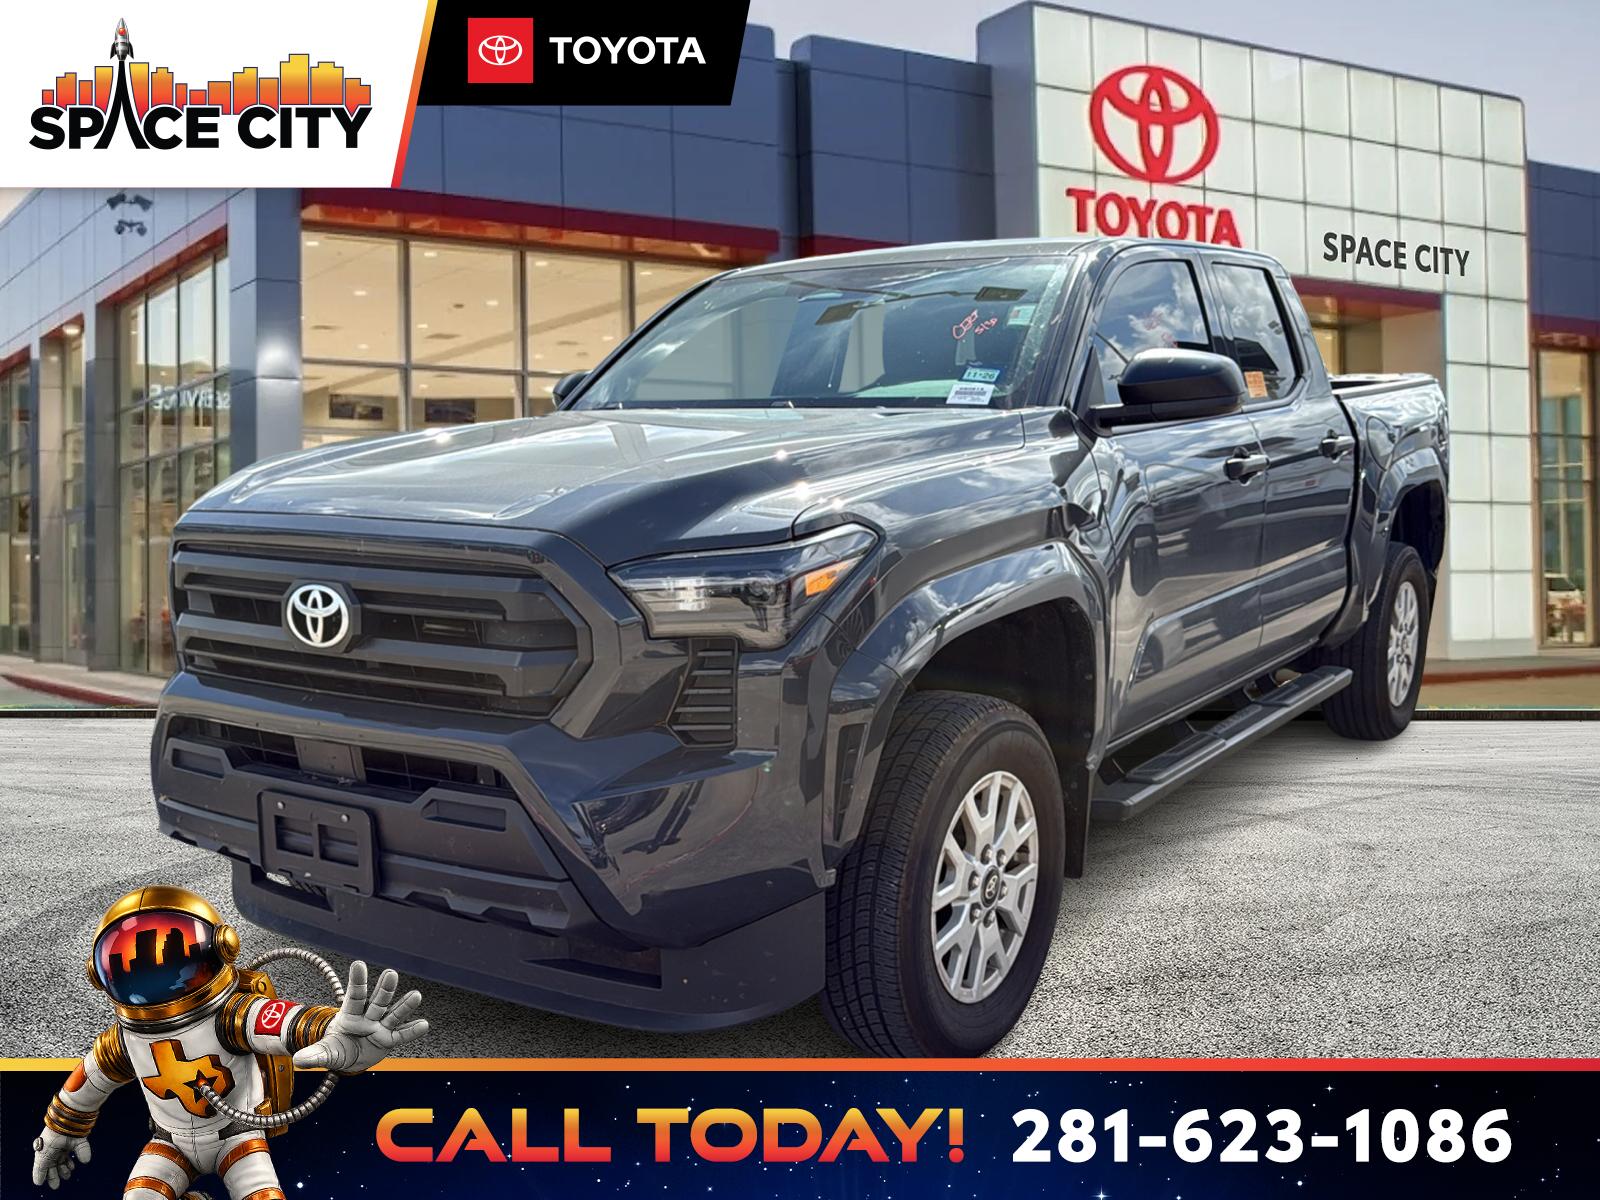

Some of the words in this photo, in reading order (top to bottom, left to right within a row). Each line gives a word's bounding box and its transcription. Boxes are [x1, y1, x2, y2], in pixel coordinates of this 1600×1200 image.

[1066, 188, 1242, 248] TOYOTA
[1323, 232, 1407, 270] SPACE
[1414, 244, 1470, 277] CITY
